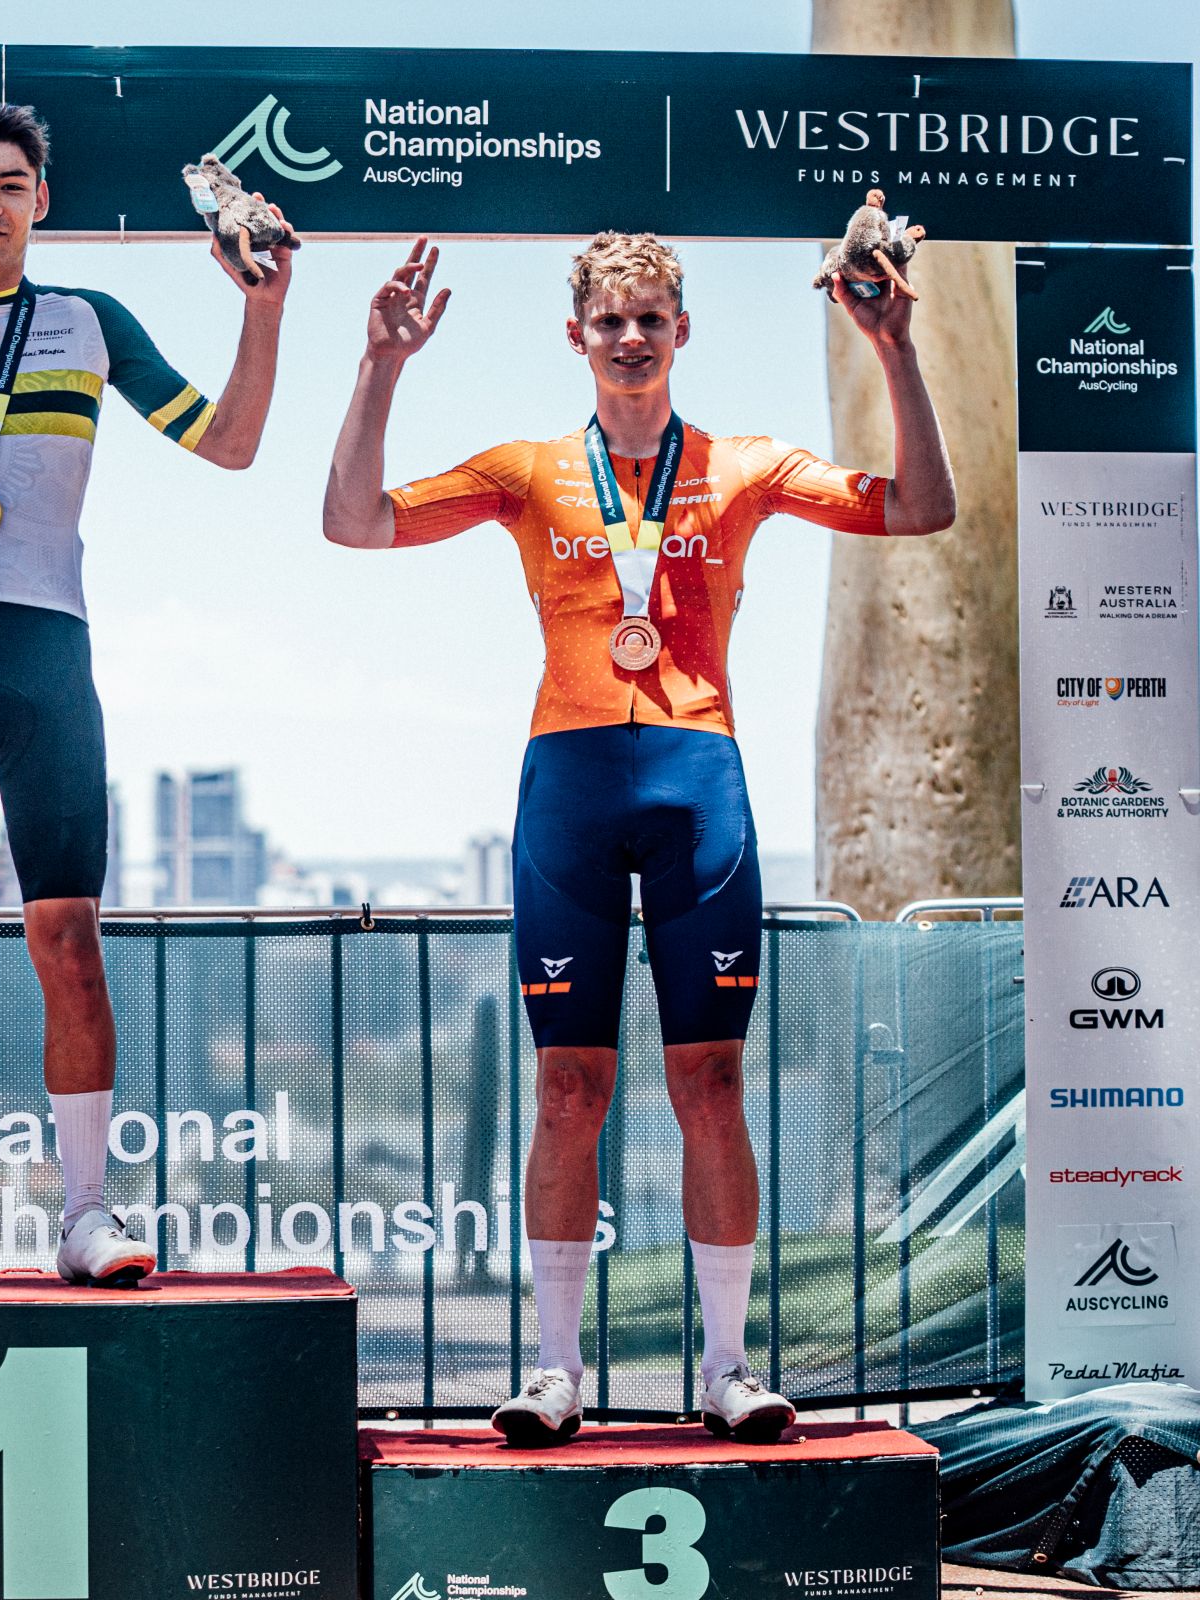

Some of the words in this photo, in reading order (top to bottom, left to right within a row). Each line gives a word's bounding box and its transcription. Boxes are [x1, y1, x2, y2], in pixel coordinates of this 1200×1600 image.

[365, 98, 489, 125] National
[735, 109, 1140, 157] WESTBRIDGE
[364, 130, 601, 164] Championships
[363, 166, 463, 187] AusCycling
[798, 169, 881, 184] FUNDS
[898, 171, 1079, 188] MANAGEMENT
[14, 307, 29, 334] National
[1070, 338, 1144, 355] National
[1036, 357, 1178, 379] Championships
[1078, 380, 1138, 393] AusCycling
[665, 442, 678, 468] National
[600, 481, 614, 508] National
[652, 467, 672, 517] Championships
[1041, 501, 1178, 517] WESTBRIDGE
[1104, 586, 1172, 595] WESTERN
[1099, 599, 1177, 608] AUSTRALIA
[1057, 678, 1085, 697] CITY
[1087, 678, 1102, 697] OF
[1127, 678, 1166, 697] PERTH
[1081, 700, 1100, 708] Light
[1061, 797, 1109, 806] BOTANIC
[1112, 797, 1164, 806] GARDENS
[1057, 808, 1065, 818] &
[1067, 808, 1103, 818] PARKS
[1105, 808, 1169, 818] AUTHORITY
[1088, 877, 1170, 908] ARA
[1069, 1009, 1164, 1029] GWM
[1050, 1087, 1184, 1108] SHIMANO
[1050, 1166, 1183, 1188] steadyrack
[1066, 1295, 1169, 1312] AUSCYCLING
[1048, 1363, 1112, 1381] Pedal
[1112, 1362, 1184, 1382] Mafia
[603, 1488, 710, 1600] 3
[187, 1570, 321, 1590] WESTBRIDGE
[447, 1574, 489, 1584] National
[784, 1566, 913, 1587] WESTBRIDGE
[447, 1585, 527, 1598] Championships
[837, 1587, 894, 1595] MANAGEMENT
